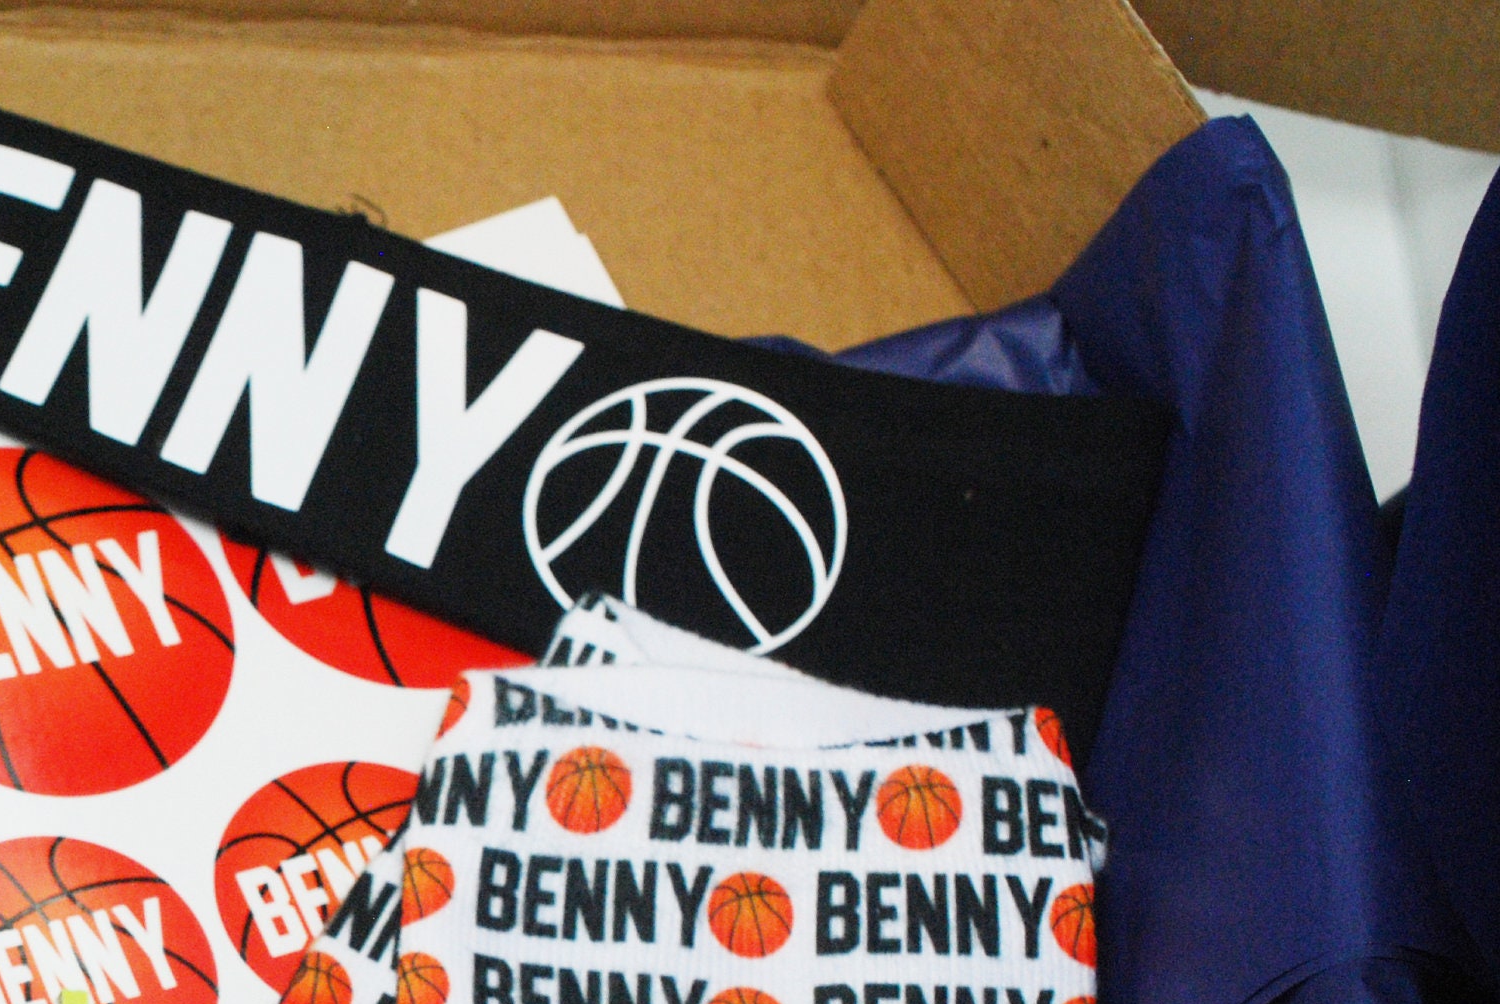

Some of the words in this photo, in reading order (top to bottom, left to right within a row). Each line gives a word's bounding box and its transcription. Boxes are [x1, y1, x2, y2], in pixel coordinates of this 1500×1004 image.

[414, 750, 549, 832] NNY
[650, 756, 876, 852] BENNY
[235, 835, 384, 958] BEN
[475, 847, 713, 948] BENNY
[815, 870, 1052, 960] BENNY
